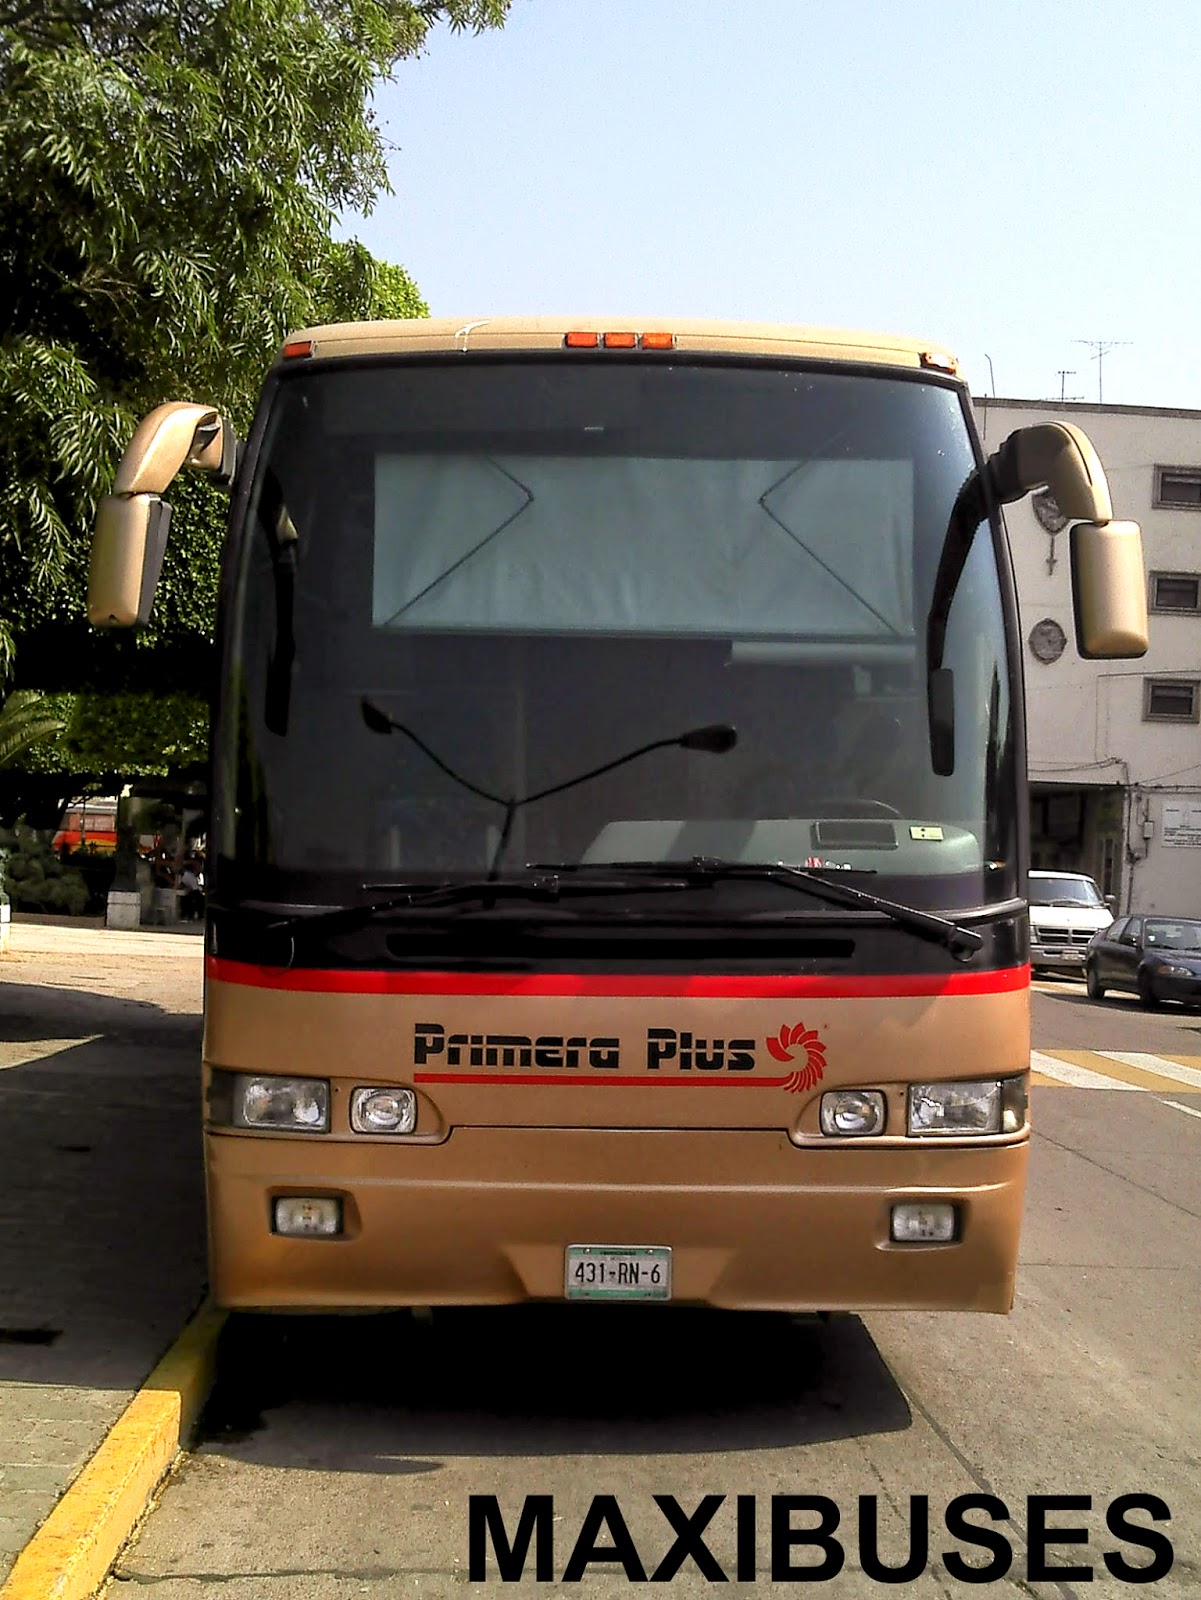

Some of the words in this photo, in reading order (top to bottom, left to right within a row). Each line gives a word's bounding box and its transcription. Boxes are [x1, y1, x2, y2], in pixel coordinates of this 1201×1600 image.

[414, 1023, 619, 1069] Primera
[647, 1028, 756, 1071] Plus
[575, 1262, 661, 1284] 431-RN-6
